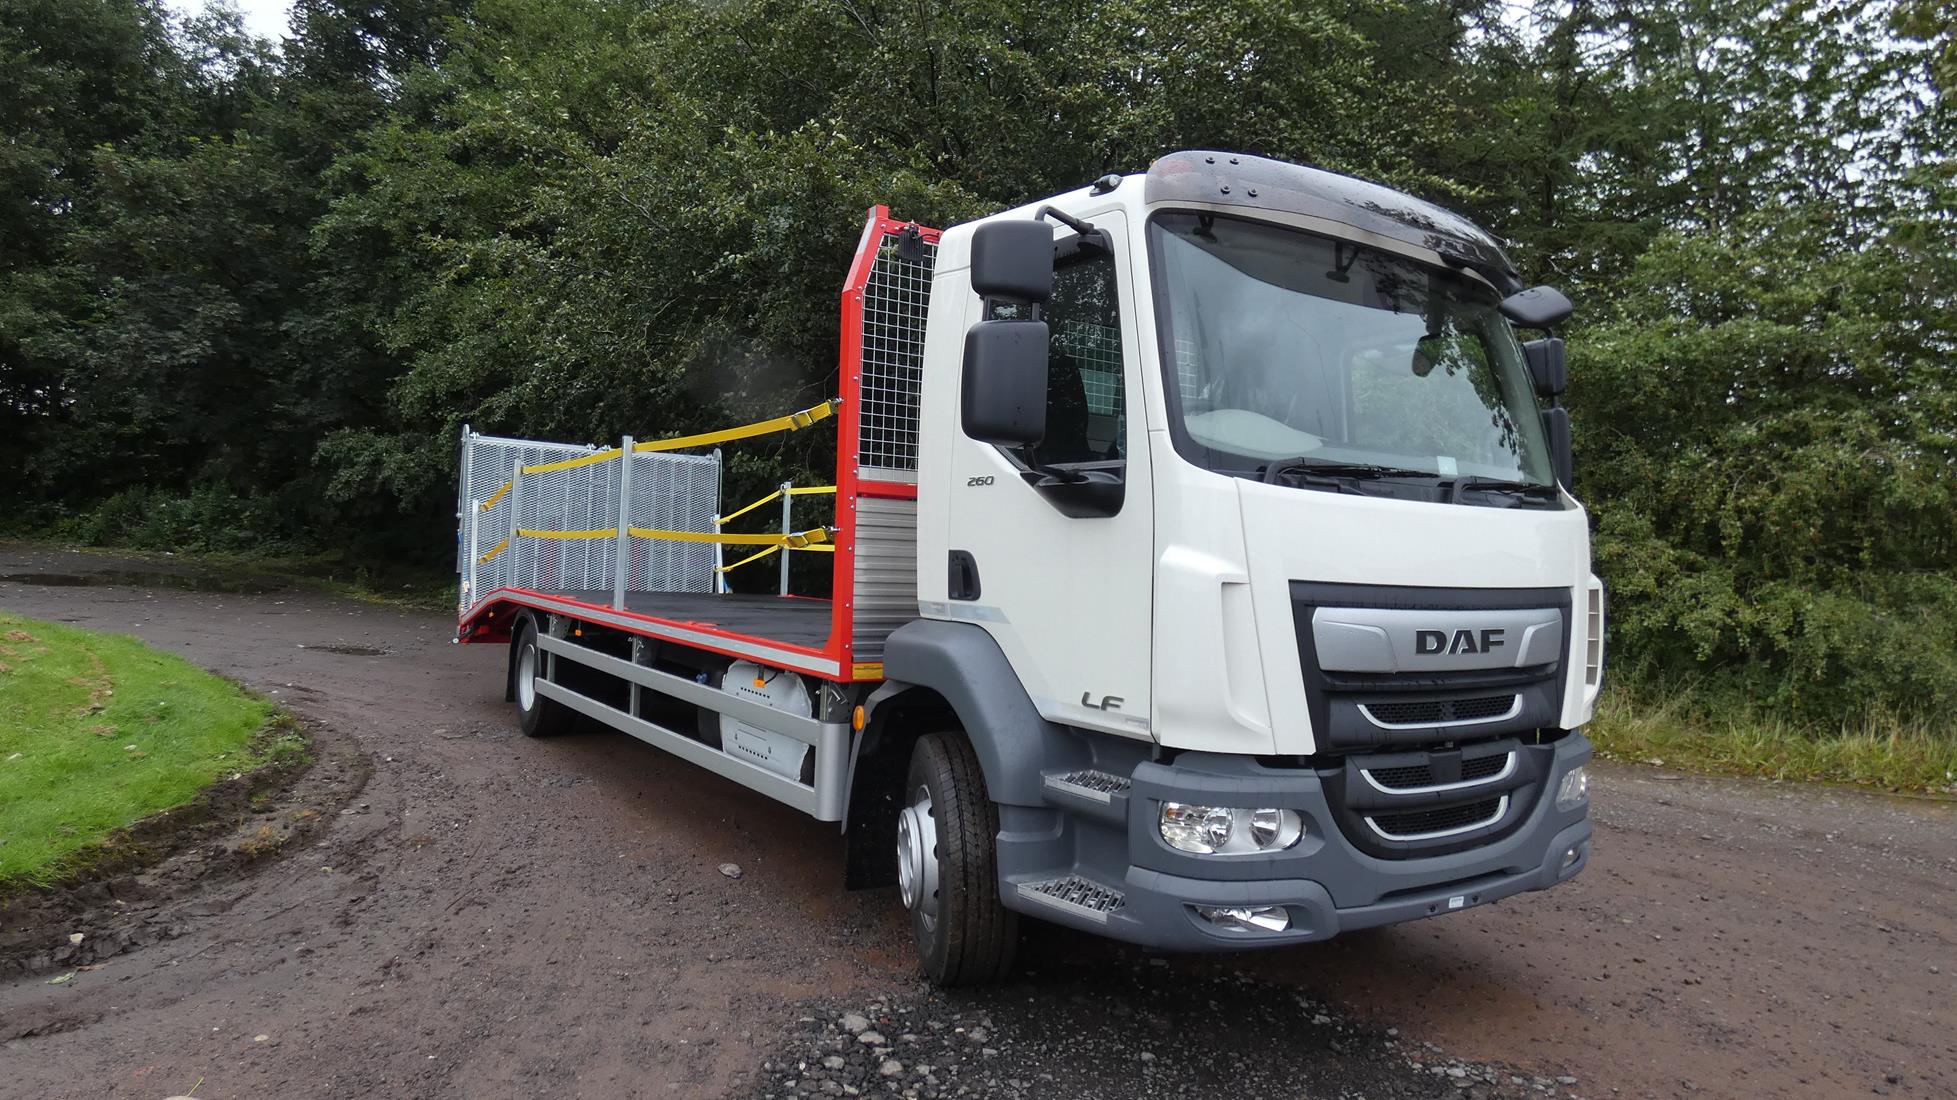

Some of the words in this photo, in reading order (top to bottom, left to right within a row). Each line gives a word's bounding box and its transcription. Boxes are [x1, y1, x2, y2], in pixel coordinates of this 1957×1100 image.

[967, 476, 994, 487] 260
[1415, 628, 1505, 655] DAF
[1081, 691, 1124, 711] LF
